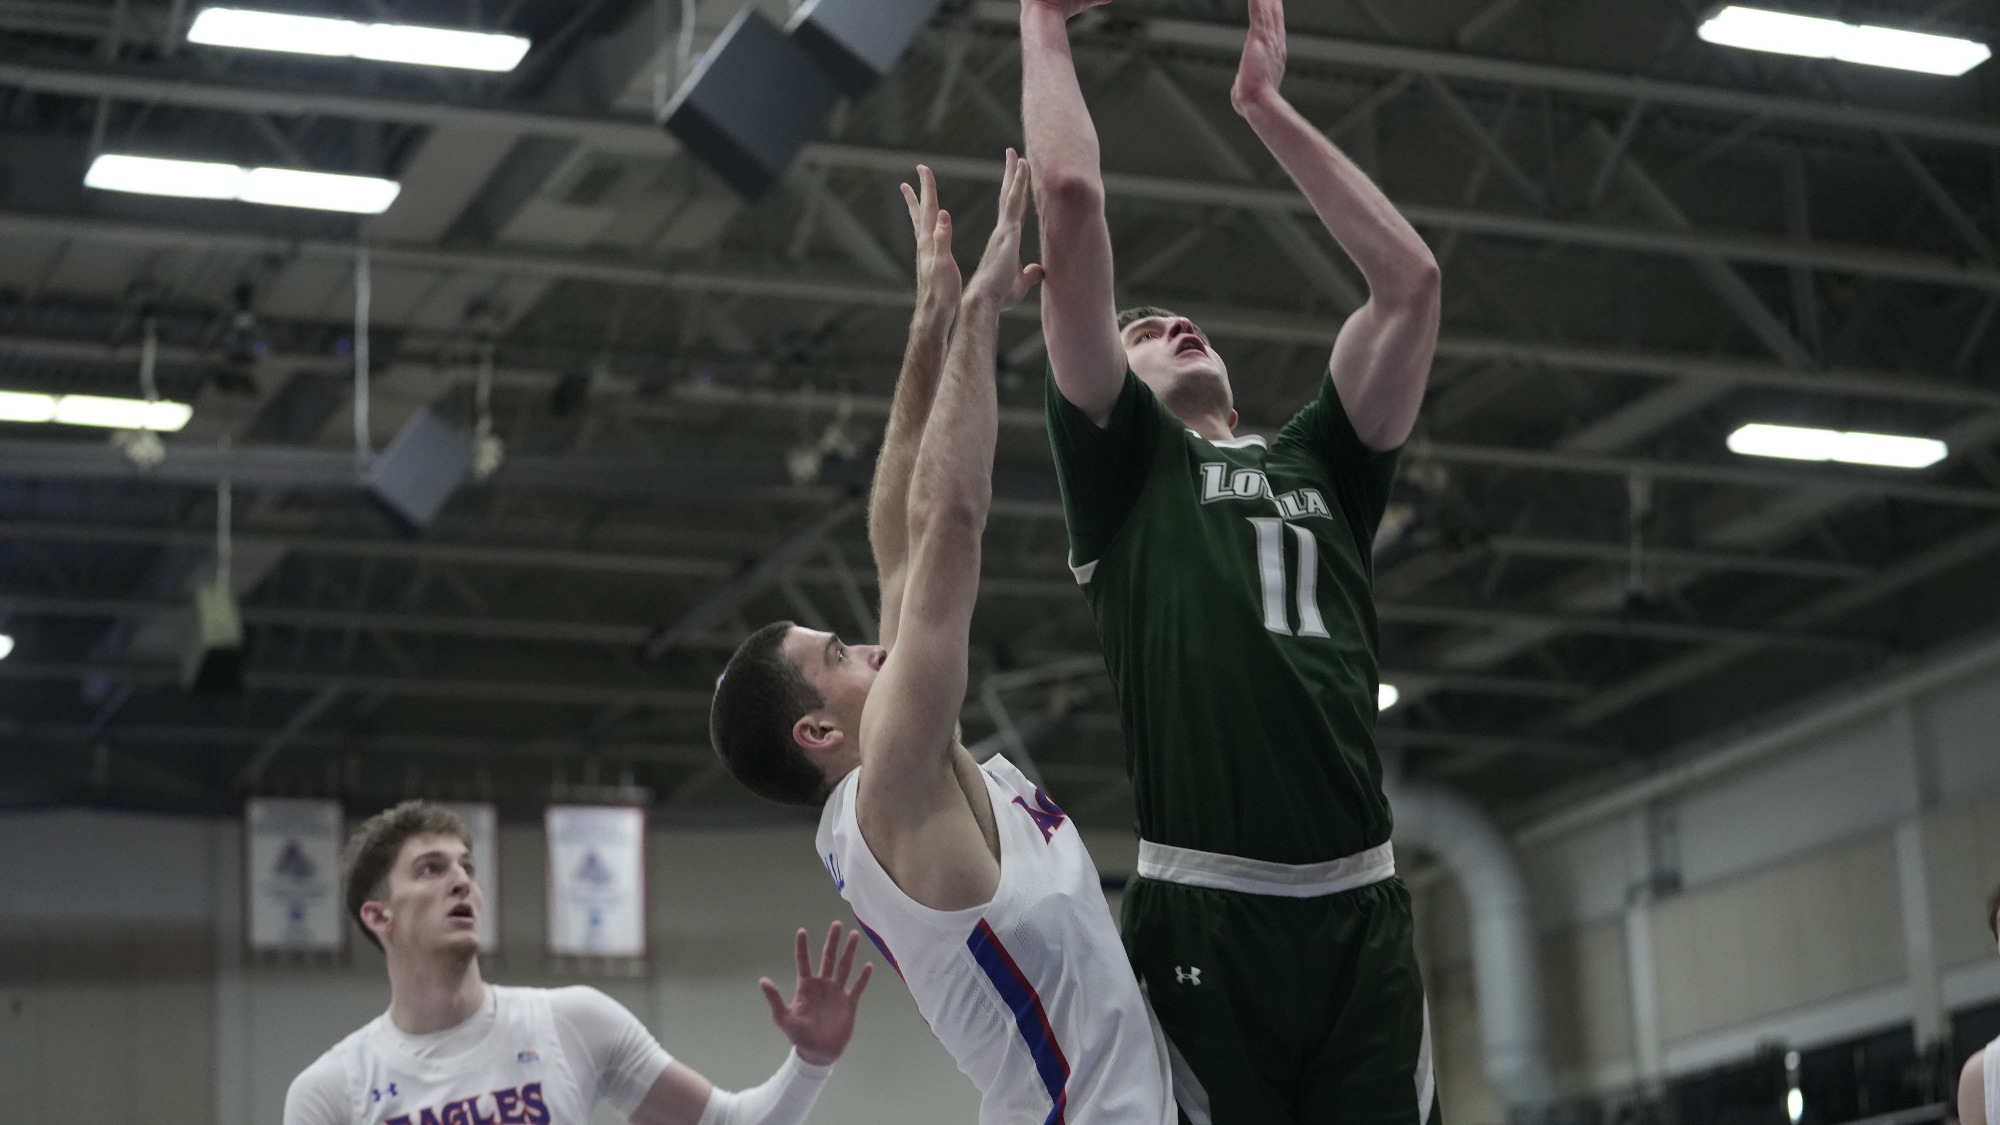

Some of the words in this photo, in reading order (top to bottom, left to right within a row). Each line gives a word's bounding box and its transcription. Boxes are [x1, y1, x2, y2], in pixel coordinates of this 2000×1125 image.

[1200, 462, 1333, 521] LOLA
[1245, 517, 1331, 639] 11
[384, 1082, 551, 1125] AGLES
